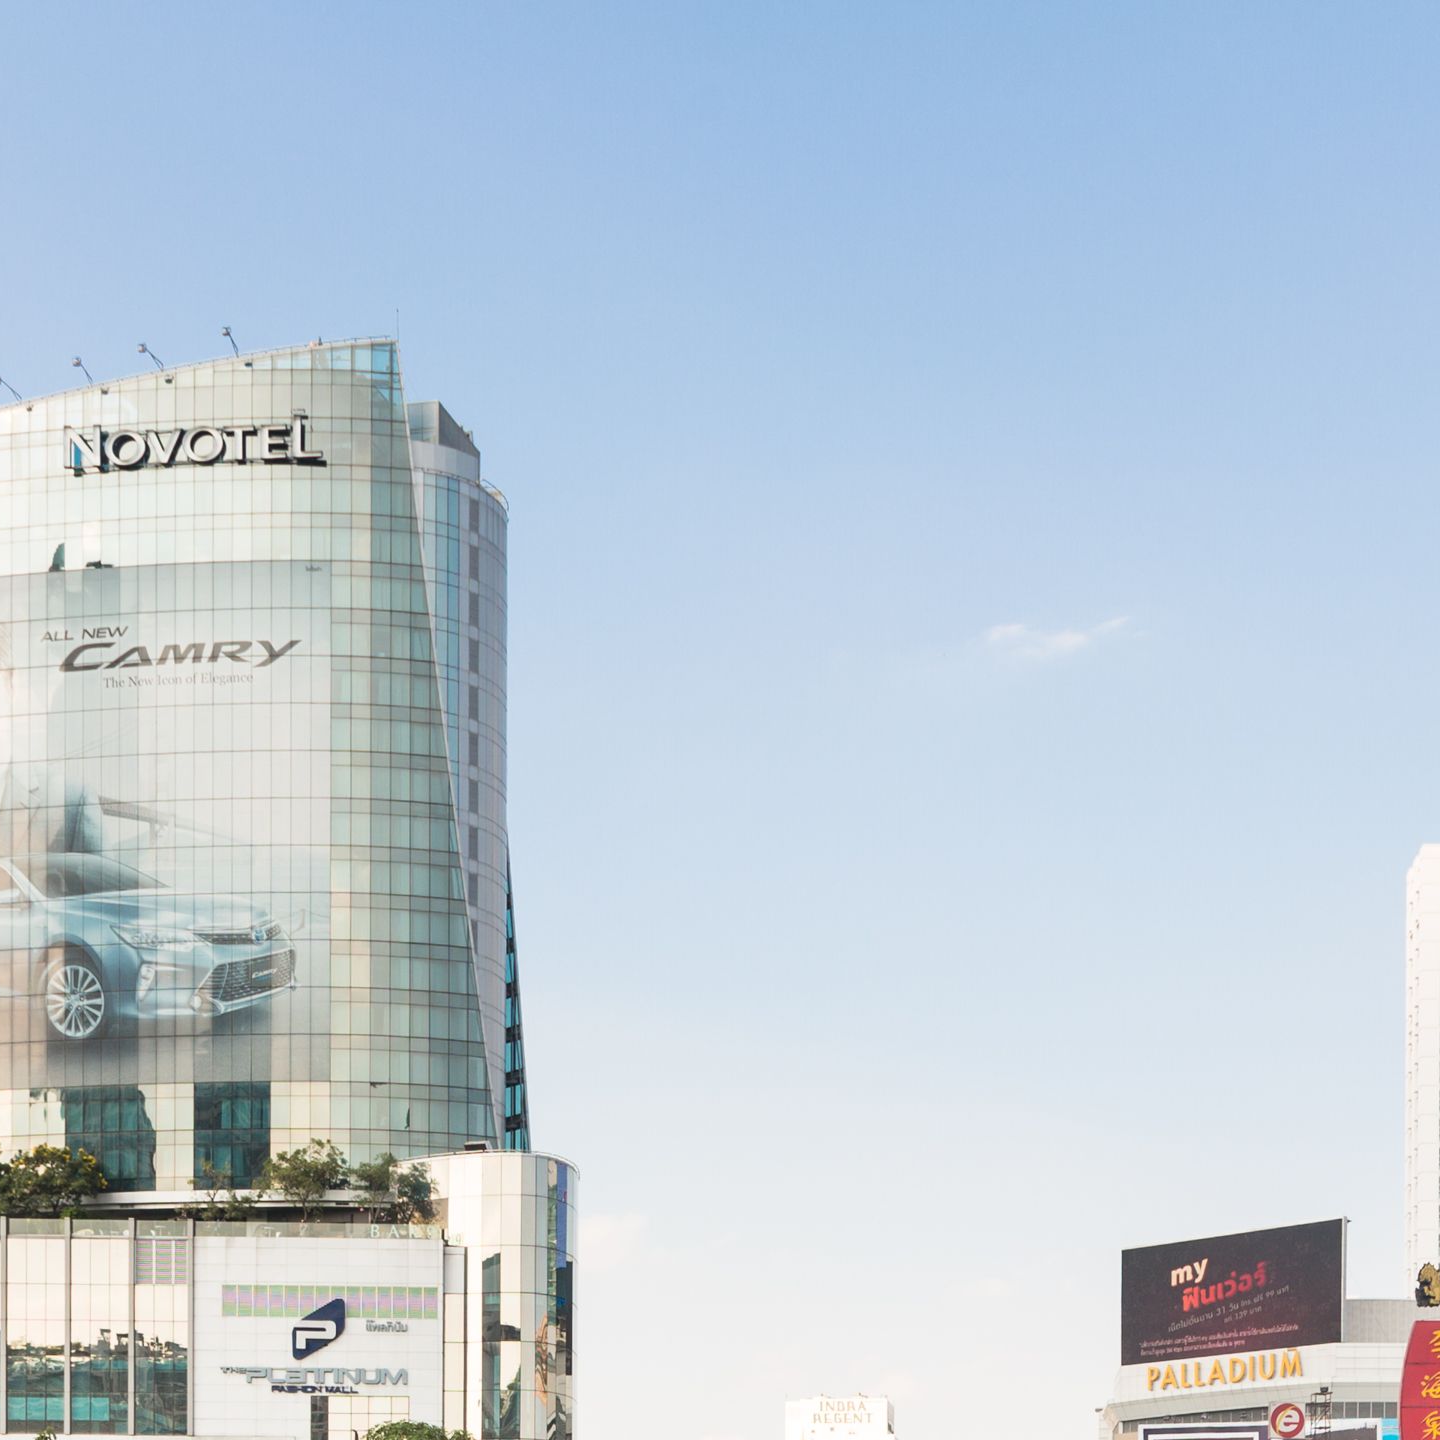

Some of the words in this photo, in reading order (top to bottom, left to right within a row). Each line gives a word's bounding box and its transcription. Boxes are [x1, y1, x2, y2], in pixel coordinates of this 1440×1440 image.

[63, 412, 328, 477] NOVOTEL
[40, 630, 74, 642] ALL
[81, 626, 128, 639] NEW
[59, 639, 303, 673] CAMRY
[103, 676, 125, 688] The
[128, 675, 152, 688] New
[158, 674, 182, 686] Icon
[185, 672, 198, 685] of
[200, 671, 254, 687] Elegance
[1170, 1258, 1208, 1287] my
[1216, 1306, 1226, 1315] 31
[1147, 1348, 1303, 1391] PALLADIUM
[324, 1386, 359, 1395] MALL
[819, 1400, 867, 1412] INDRA
[813, 1413, 873, 1424] REGENT
